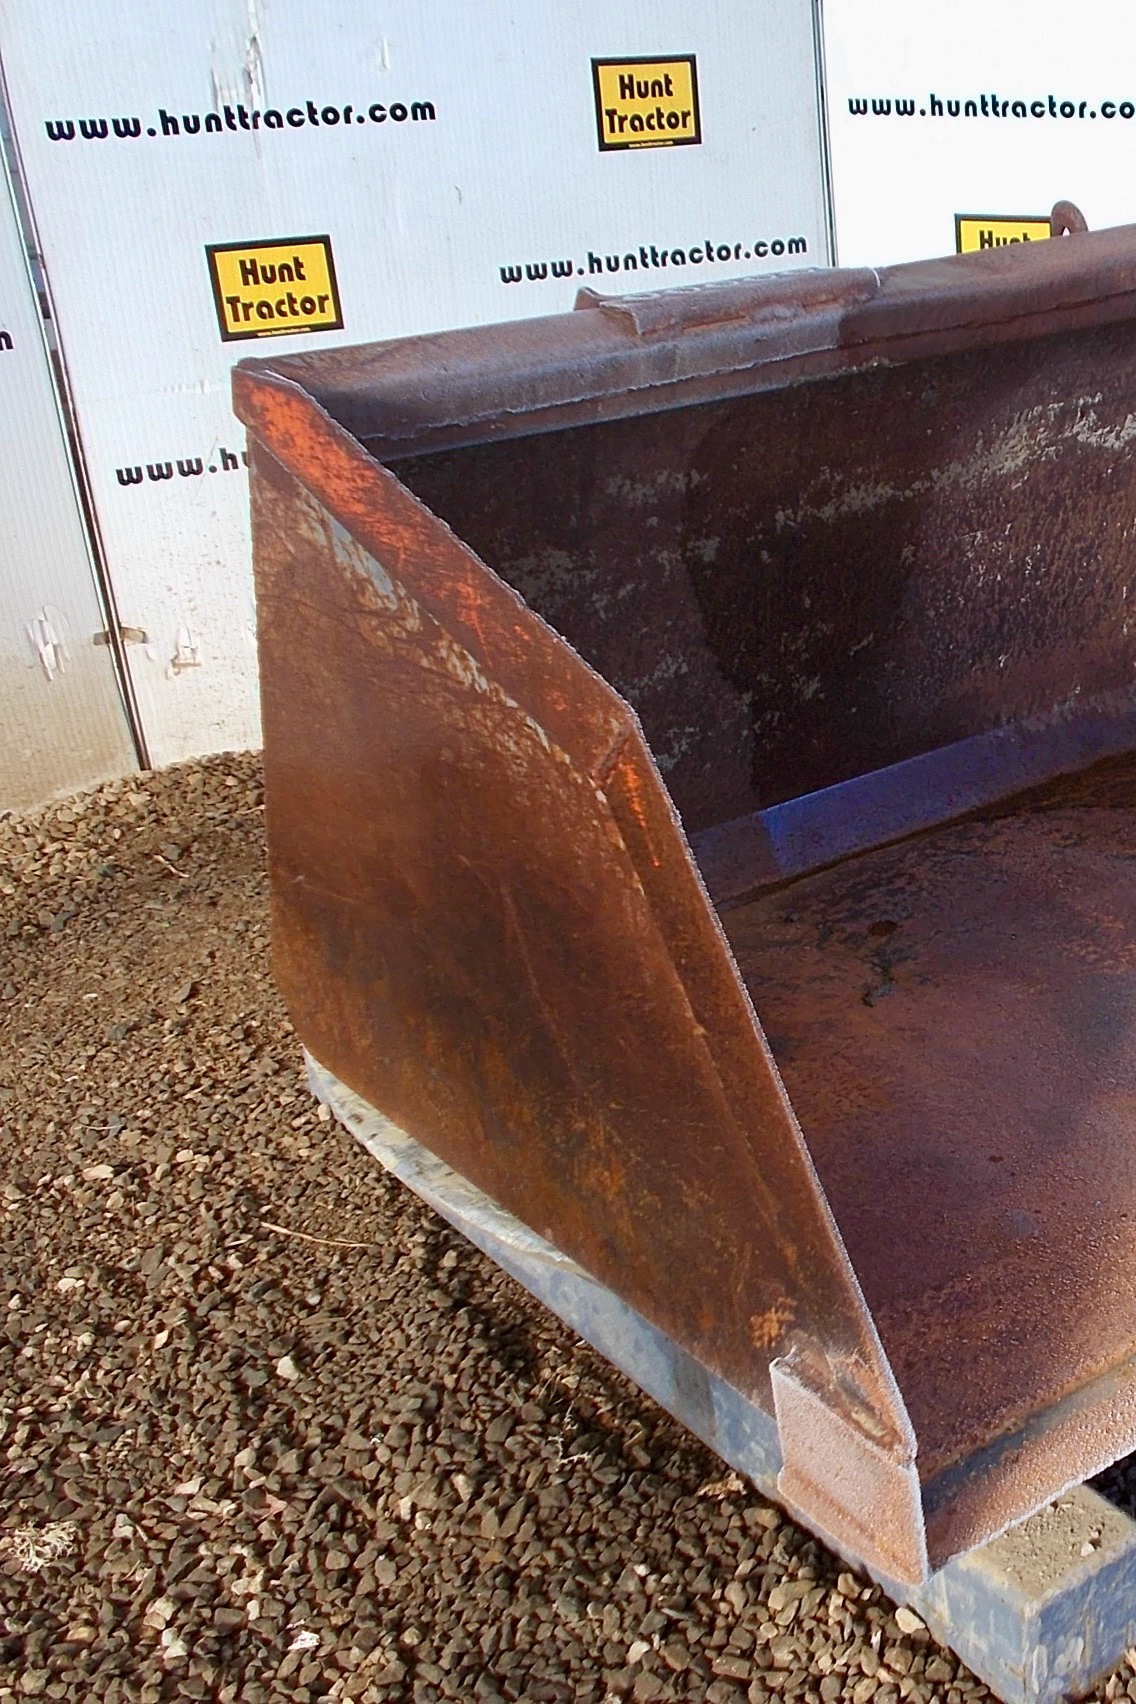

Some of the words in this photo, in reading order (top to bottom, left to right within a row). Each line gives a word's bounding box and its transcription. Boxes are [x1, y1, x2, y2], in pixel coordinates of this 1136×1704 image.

[618, 74, 673, 99] Hunt
[45, 101, 436, 141] www.hunttractor.com
[605, 107, 691, 133] Tractor
[238, 256, 306, 286] Hunt
[500, 236, 807, 284] www.hunttractor.com
[225, 292, 329, 322] Tractor
